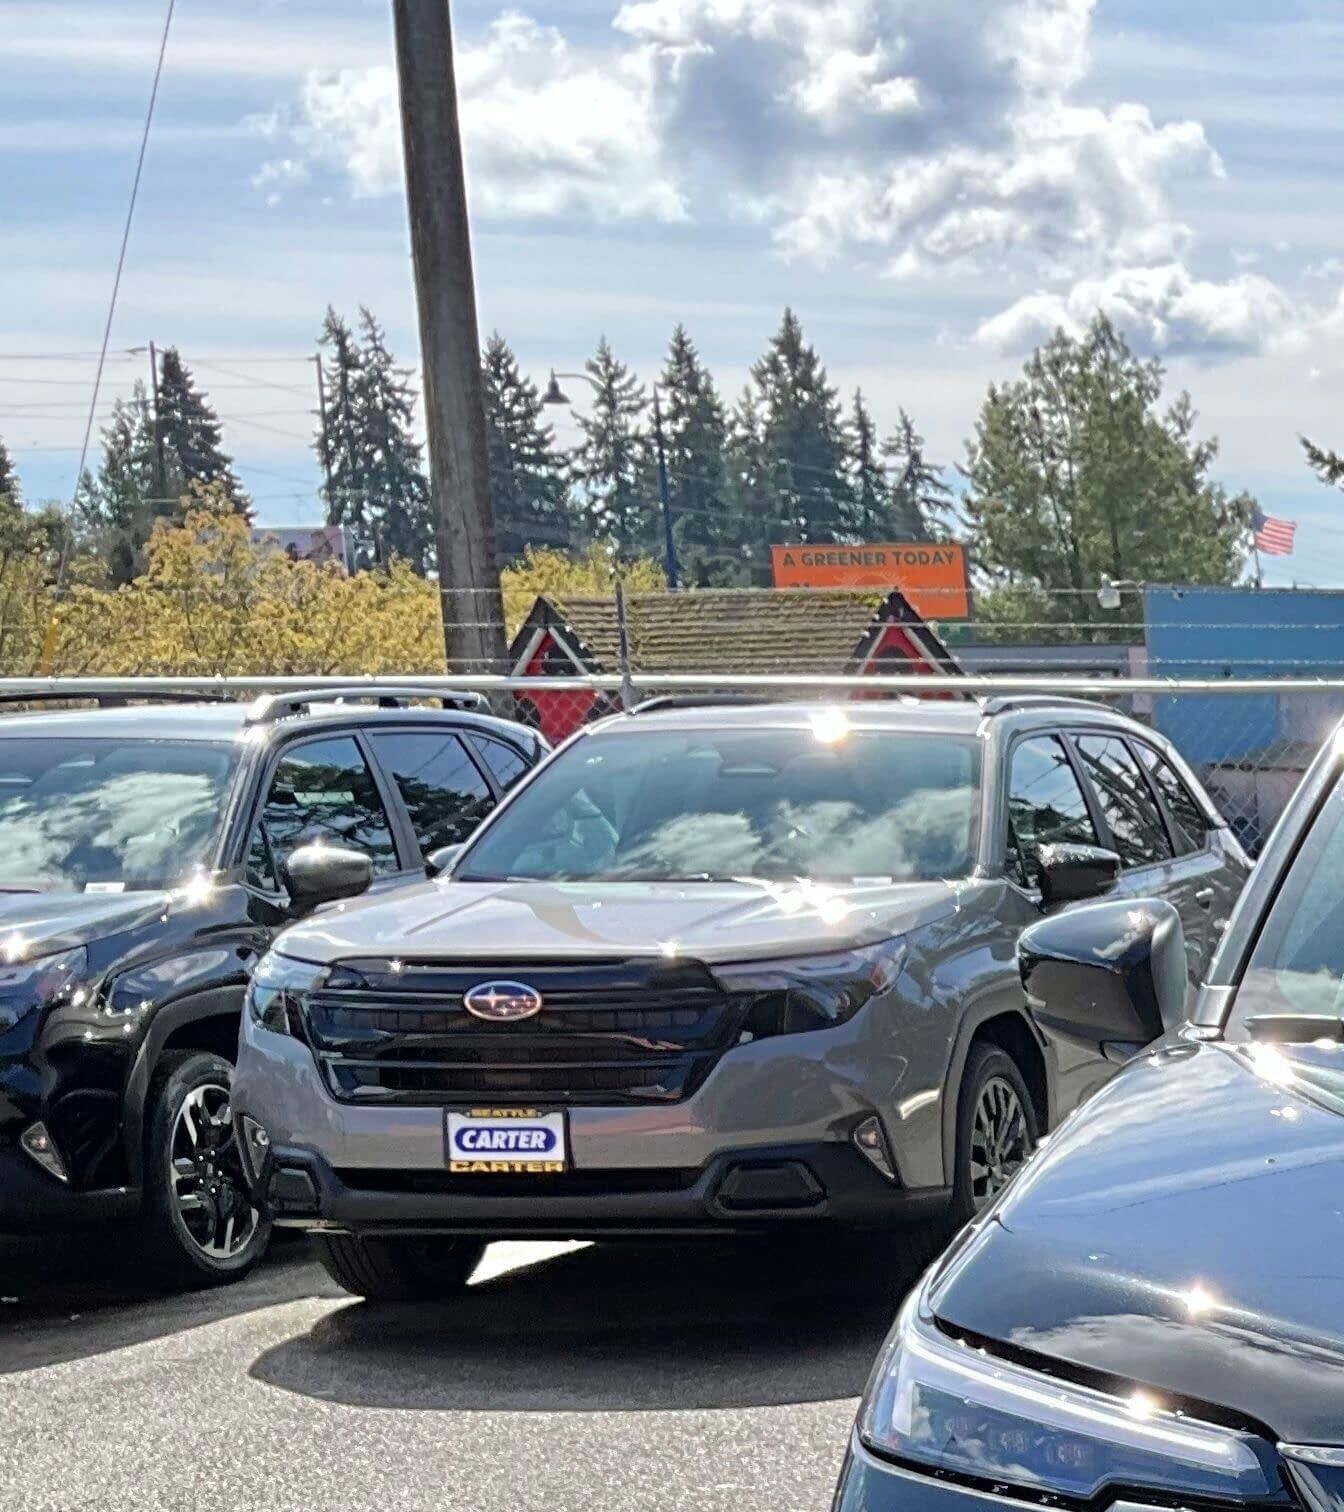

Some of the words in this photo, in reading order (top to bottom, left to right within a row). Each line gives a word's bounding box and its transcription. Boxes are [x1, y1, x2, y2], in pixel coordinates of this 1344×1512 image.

[782, 552, 796, 567] A
[801, 552, 886, 567] GREENER
[892, 551, 955, 566] TODAY
[470, 1108, 537, 1118] SEATTLE
[462, 1130, 547, 1149] CARTER
[449, 1161, 564, 1172] CARTER
